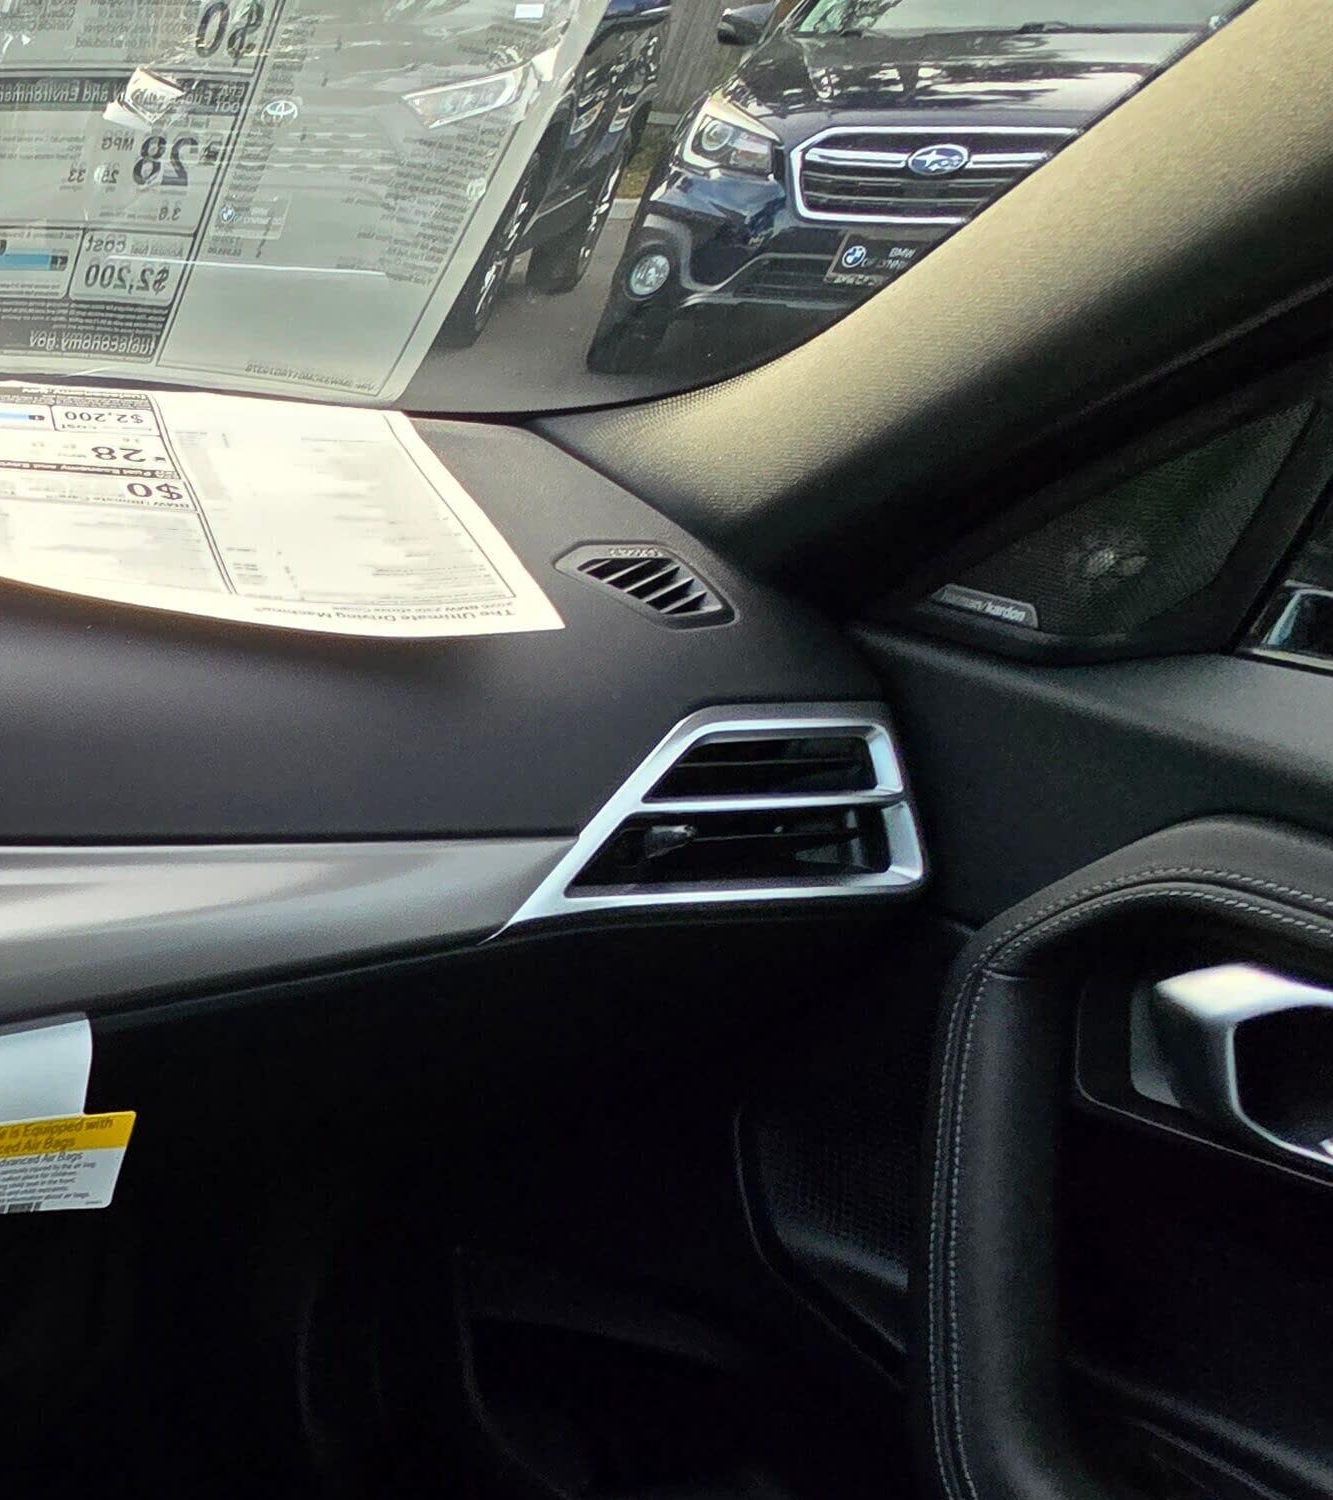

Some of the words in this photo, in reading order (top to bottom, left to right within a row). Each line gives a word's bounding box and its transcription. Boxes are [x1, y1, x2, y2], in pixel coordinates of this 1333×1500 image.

[64, 410, 144, 424] $2,200
[91, 445, 147, 463] 28
[126, 481, 183, 501] $0
[22, 1116, 84, 1138] Equipped
[85, 1116, 114, 1130] with
[44, 1136, 76, 1152] Bags
[56, 1151, 84, 1163] Bags
